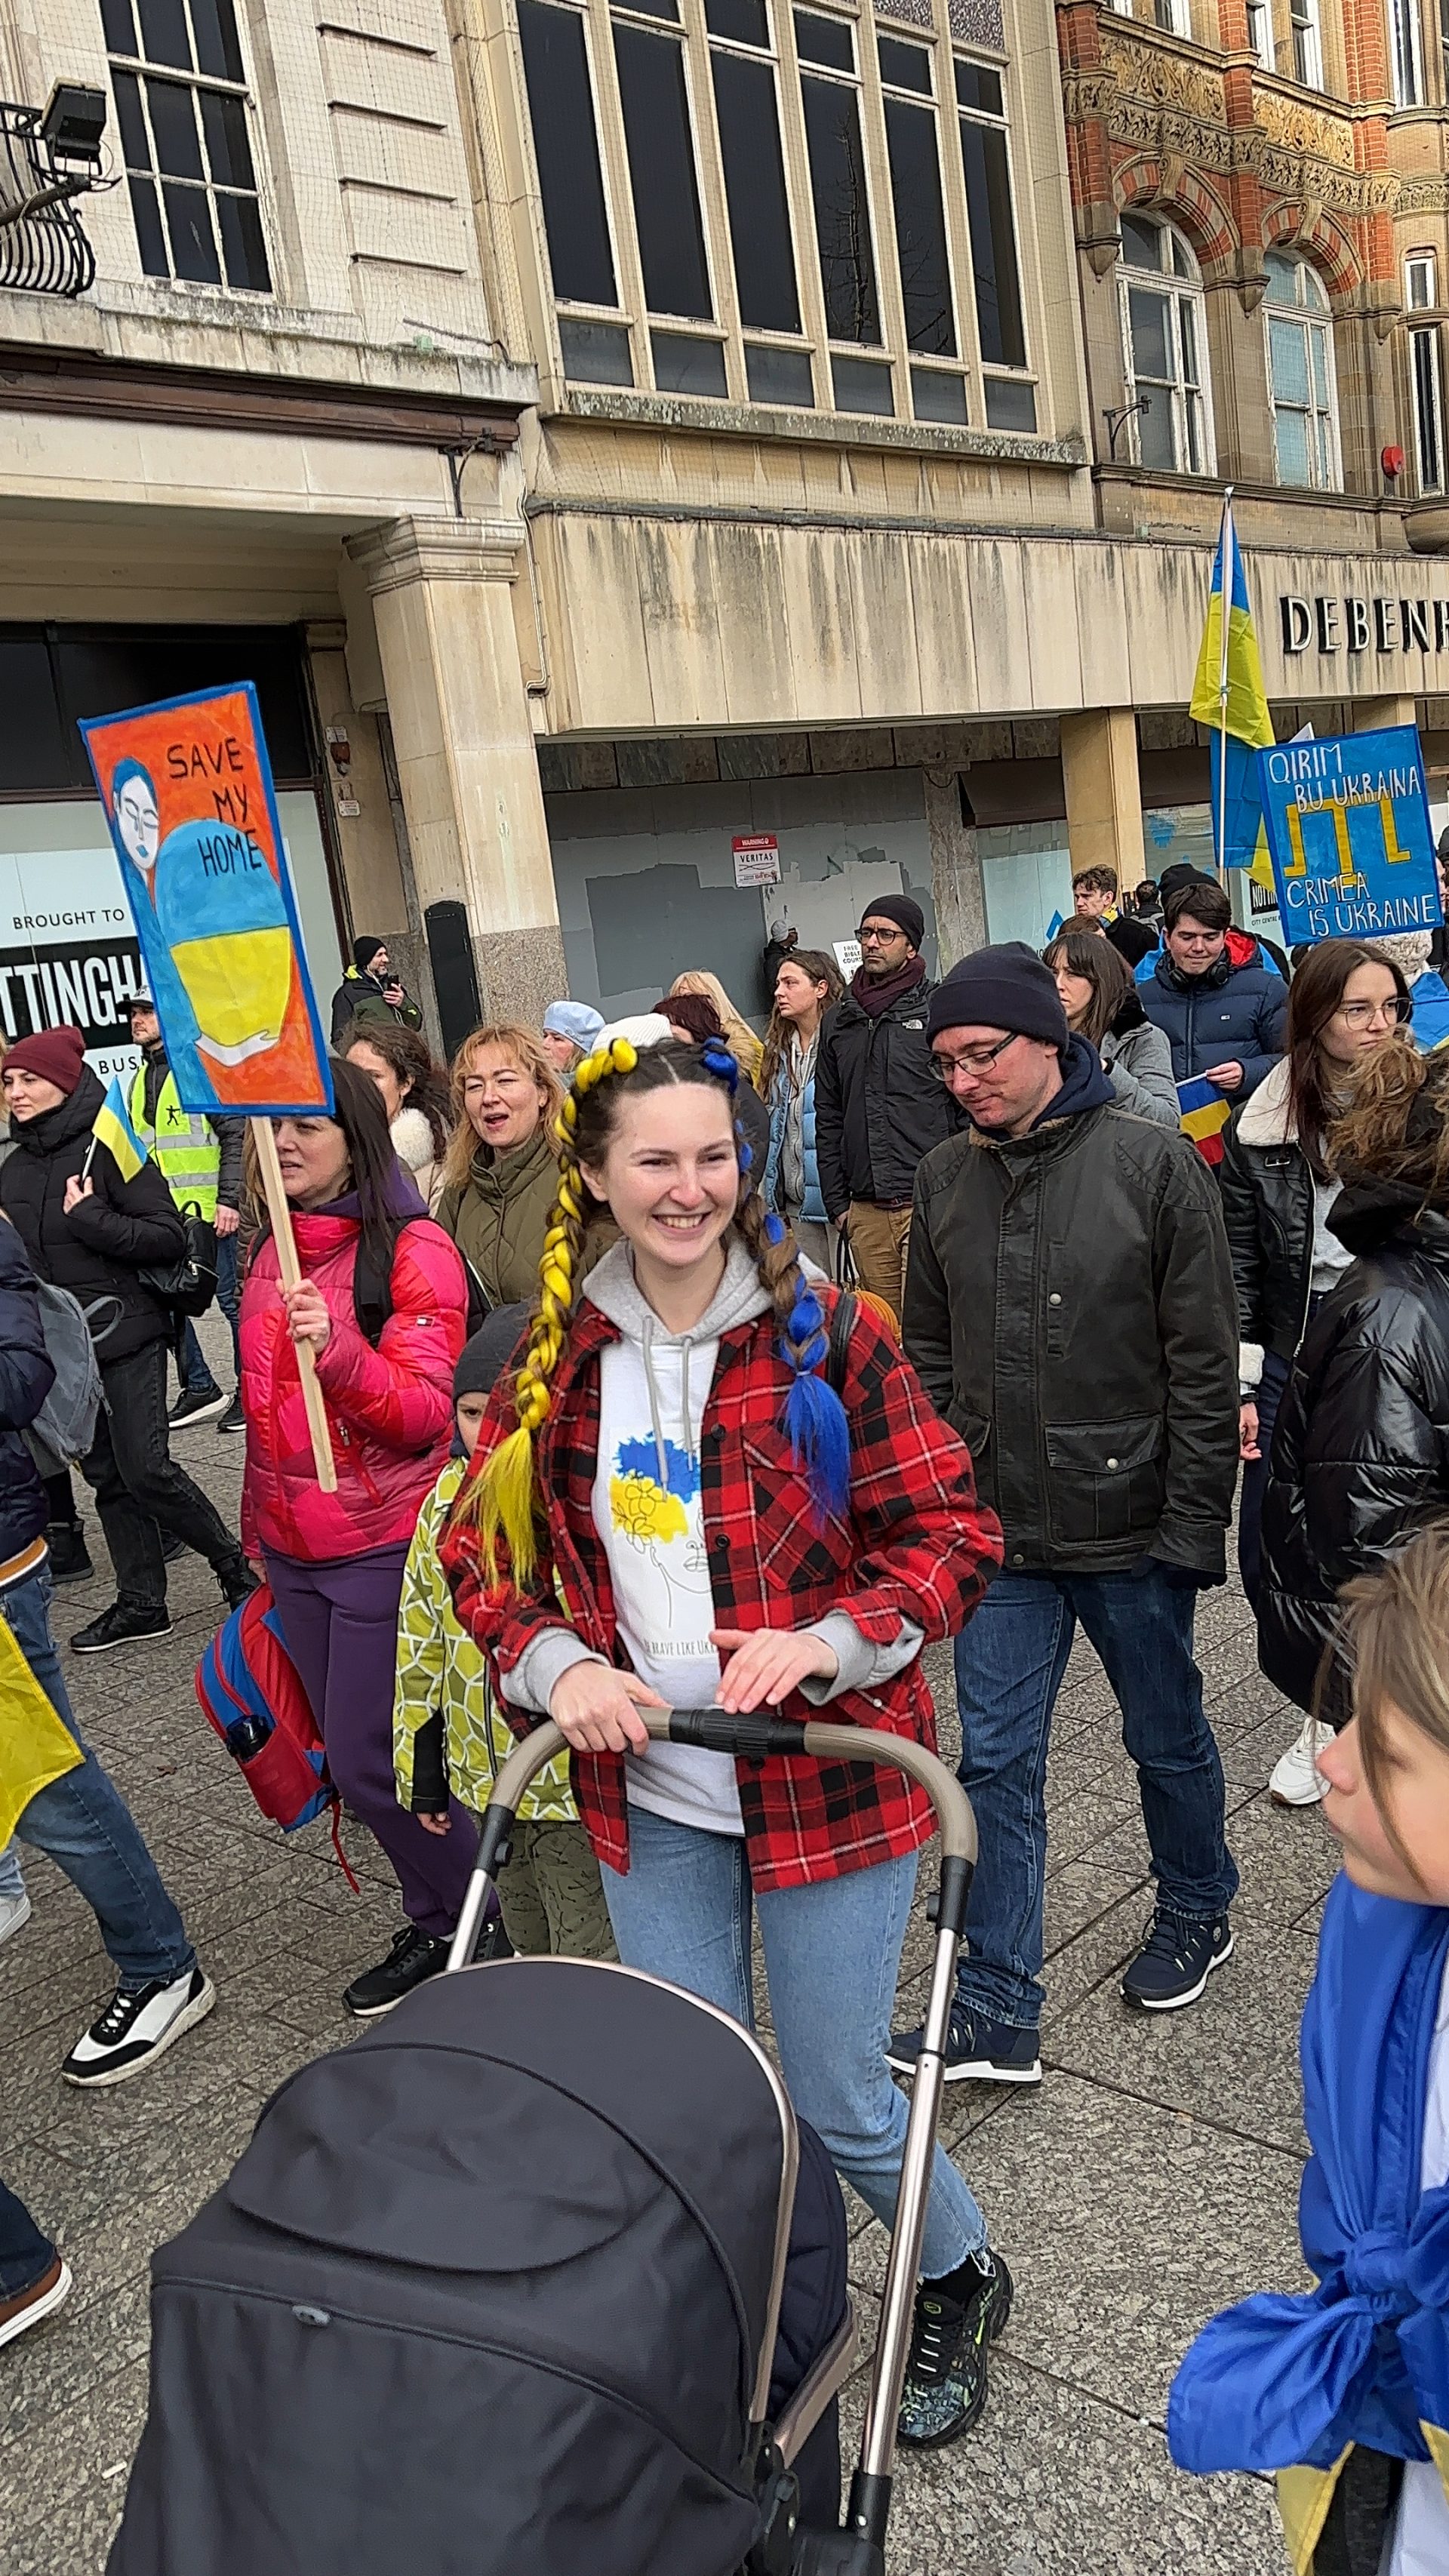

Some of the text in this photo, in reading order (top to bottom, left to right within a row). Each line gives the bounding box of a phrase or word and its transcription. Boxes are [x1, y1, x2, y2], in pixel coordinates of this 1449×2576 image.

[167, 737, 244, 779] SAVE
[1269, 743, 1343, 784] QIRIM
[212, 783, 248, 823] MY
[1294, 766, 1422, 813] BU UKRAINA
[197, 828, 262, 876] HOME
[740, 853, 774, 863] VERITAS
[1287, 872, 1371, 908] CRIMEA
[13, 909, 125, 929] BROUGHT TO
[1309, 894, 1435, 937] IS UKRAINE
[651, 1642, 674, 1656] BRAVE
[676, 1642, 695, 1655] LIKE
